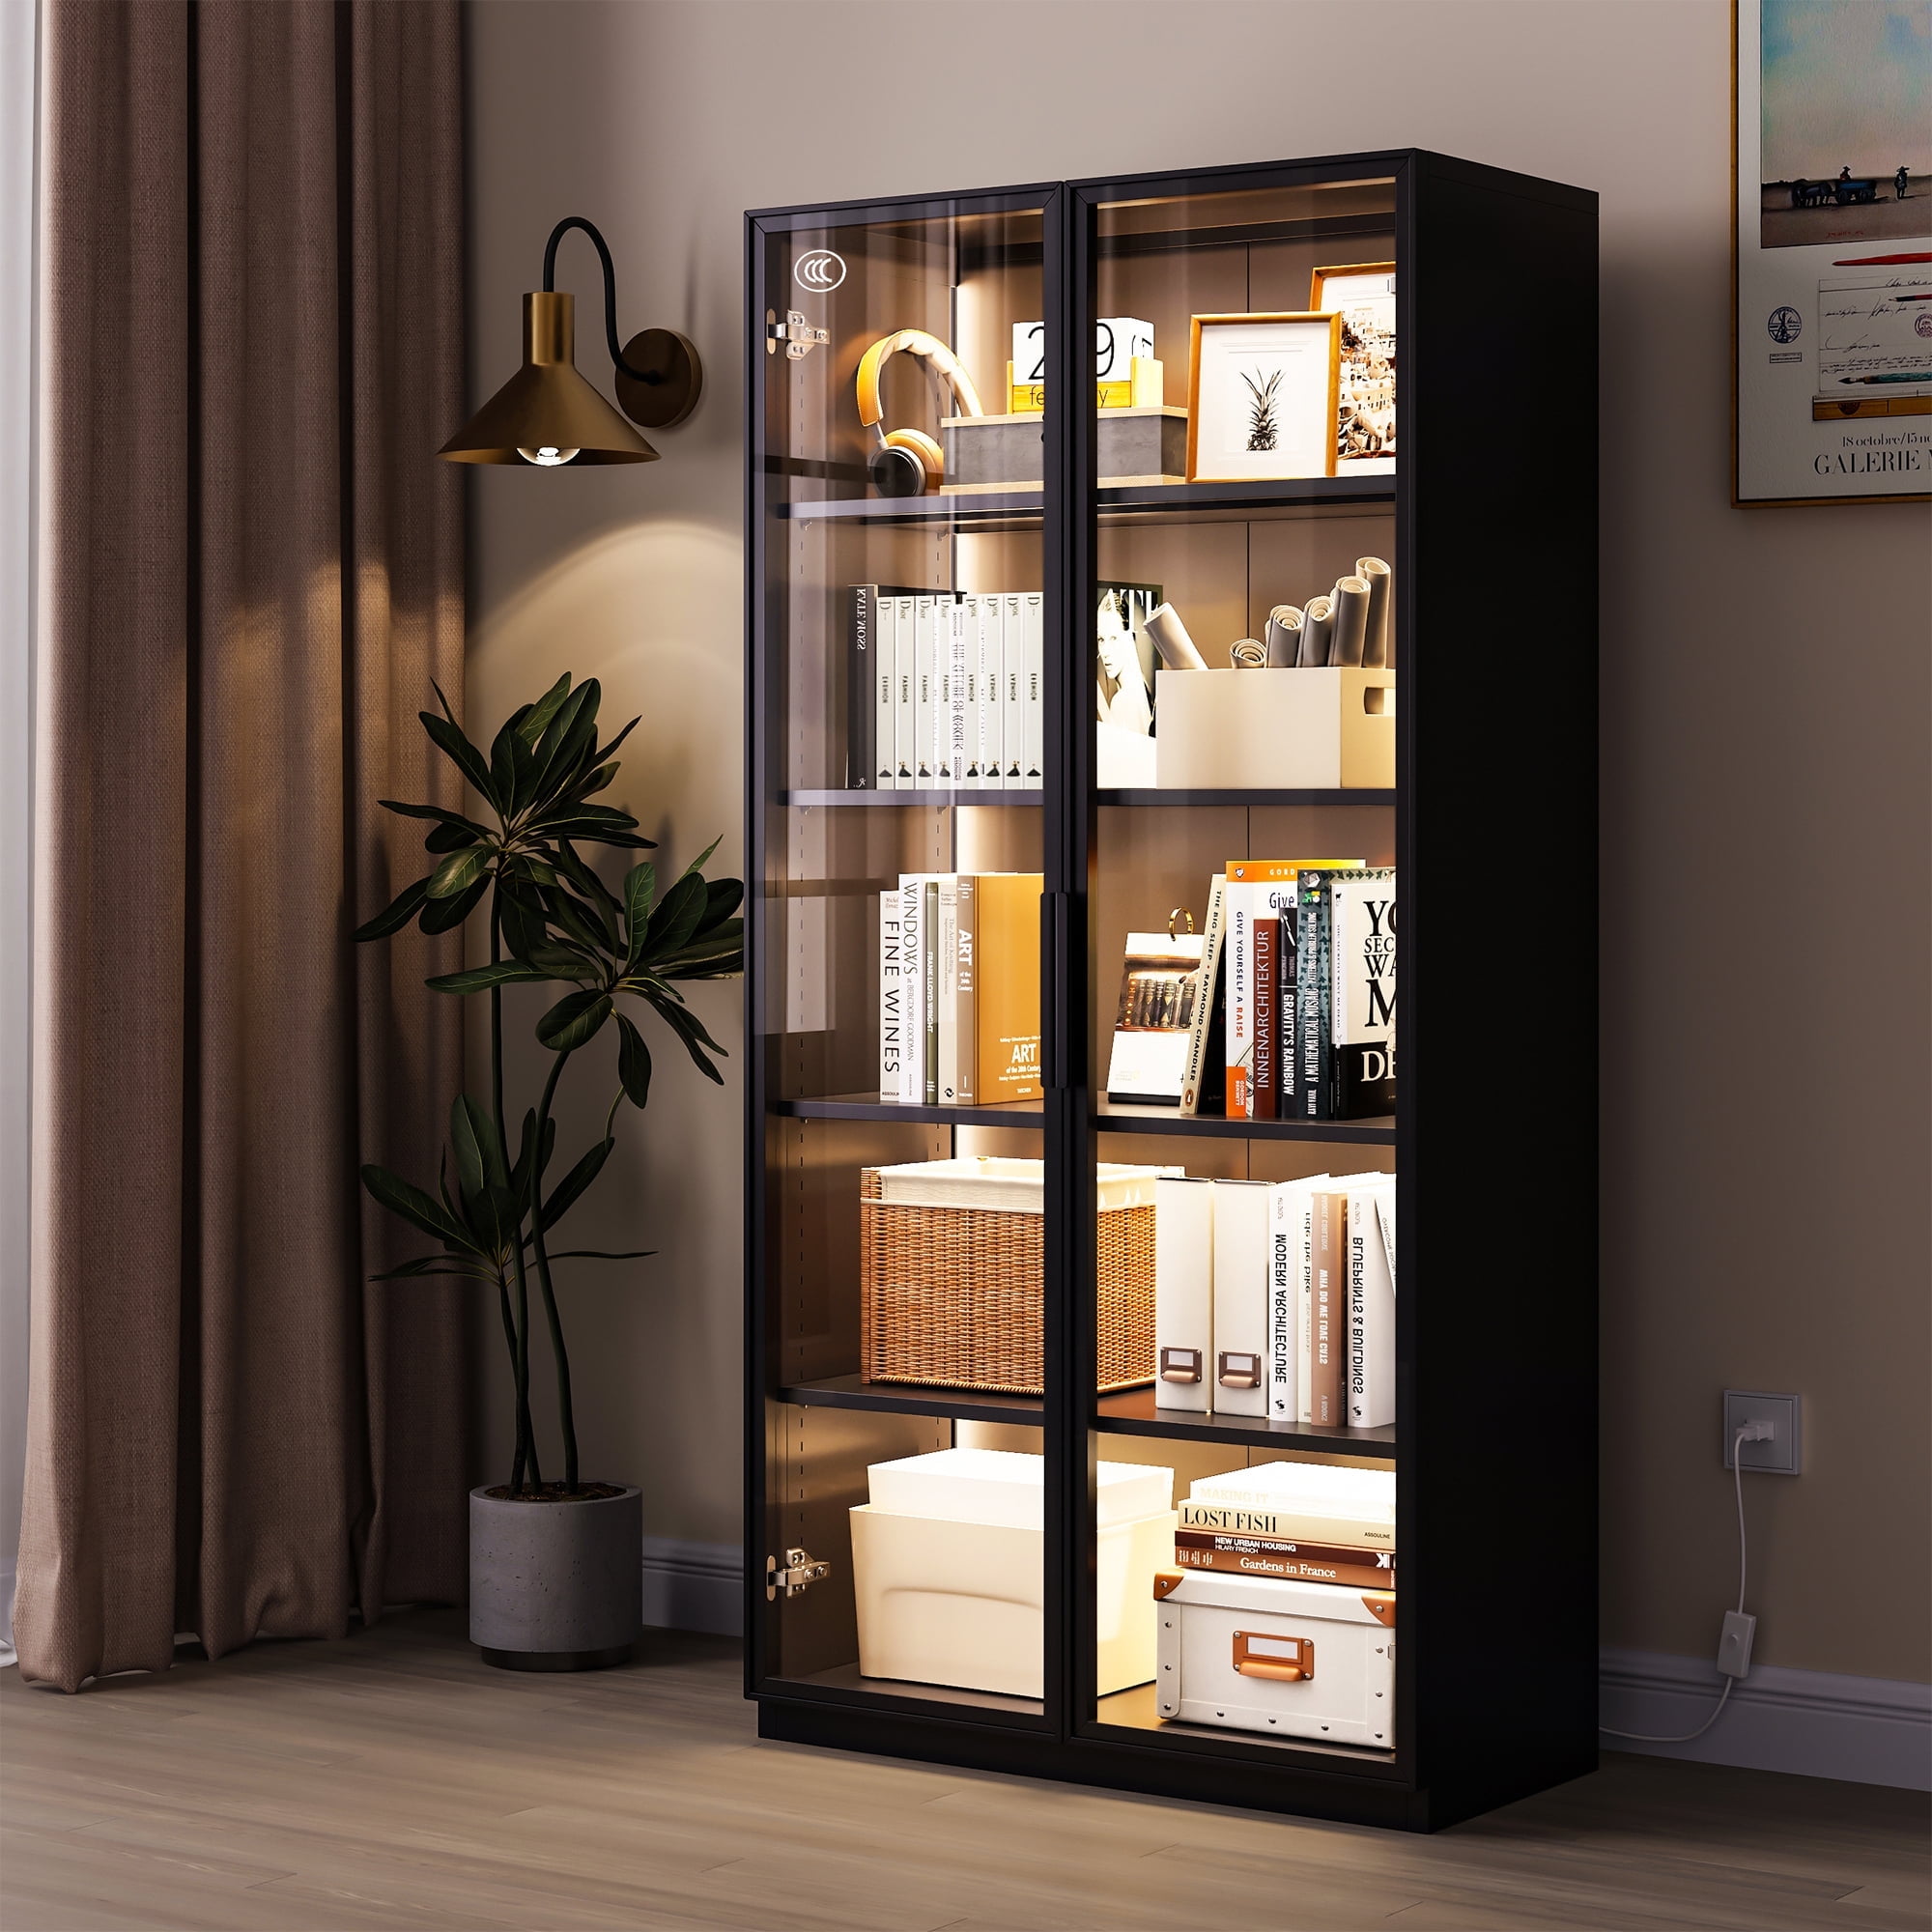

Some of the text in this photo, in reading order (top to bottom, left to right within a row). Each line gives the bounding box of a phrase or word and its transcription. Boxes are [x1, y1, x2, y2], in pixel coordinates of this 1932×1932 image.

[1842, 436, 1854, 447] 18
[1813, 449, 1920, 475] GALERIE
[1268, 891, 1295, 910] Give
[903, 882, 918, 975] WINDOWS
[884, 921, 899, 977] FINE
[958, 928, 973, 966] ART
[1207, 932, 1216, 961] SLEEP
[1196, 974, 1209, 1026] RAYMOND
[1257, 929, 1269, 1089] INNENARCHITEKTUR
[1305, 987, 1320, 1017] MOSAIC
[884, 989, 899, 1073] WINES
[1011, 1043, 1037, 1064] ART
[1189, 1028, 1202, 1082] CHANDLER
[1305, 1018, 1320, 1075] MATHEMATICAL
[1283, 1049, 1294, 1095] RAINBOW
[1200, 1488, 1252, 1501] MAKING
[1255, 1492, 1268, 1503] IT
[1183, 1507, 1277, 1533] LOST FISH
[1215, 1537, 1296, 1552] NEW URBAN HOUSING
[1239, 1556, 1337, 1578] Gardens in France
